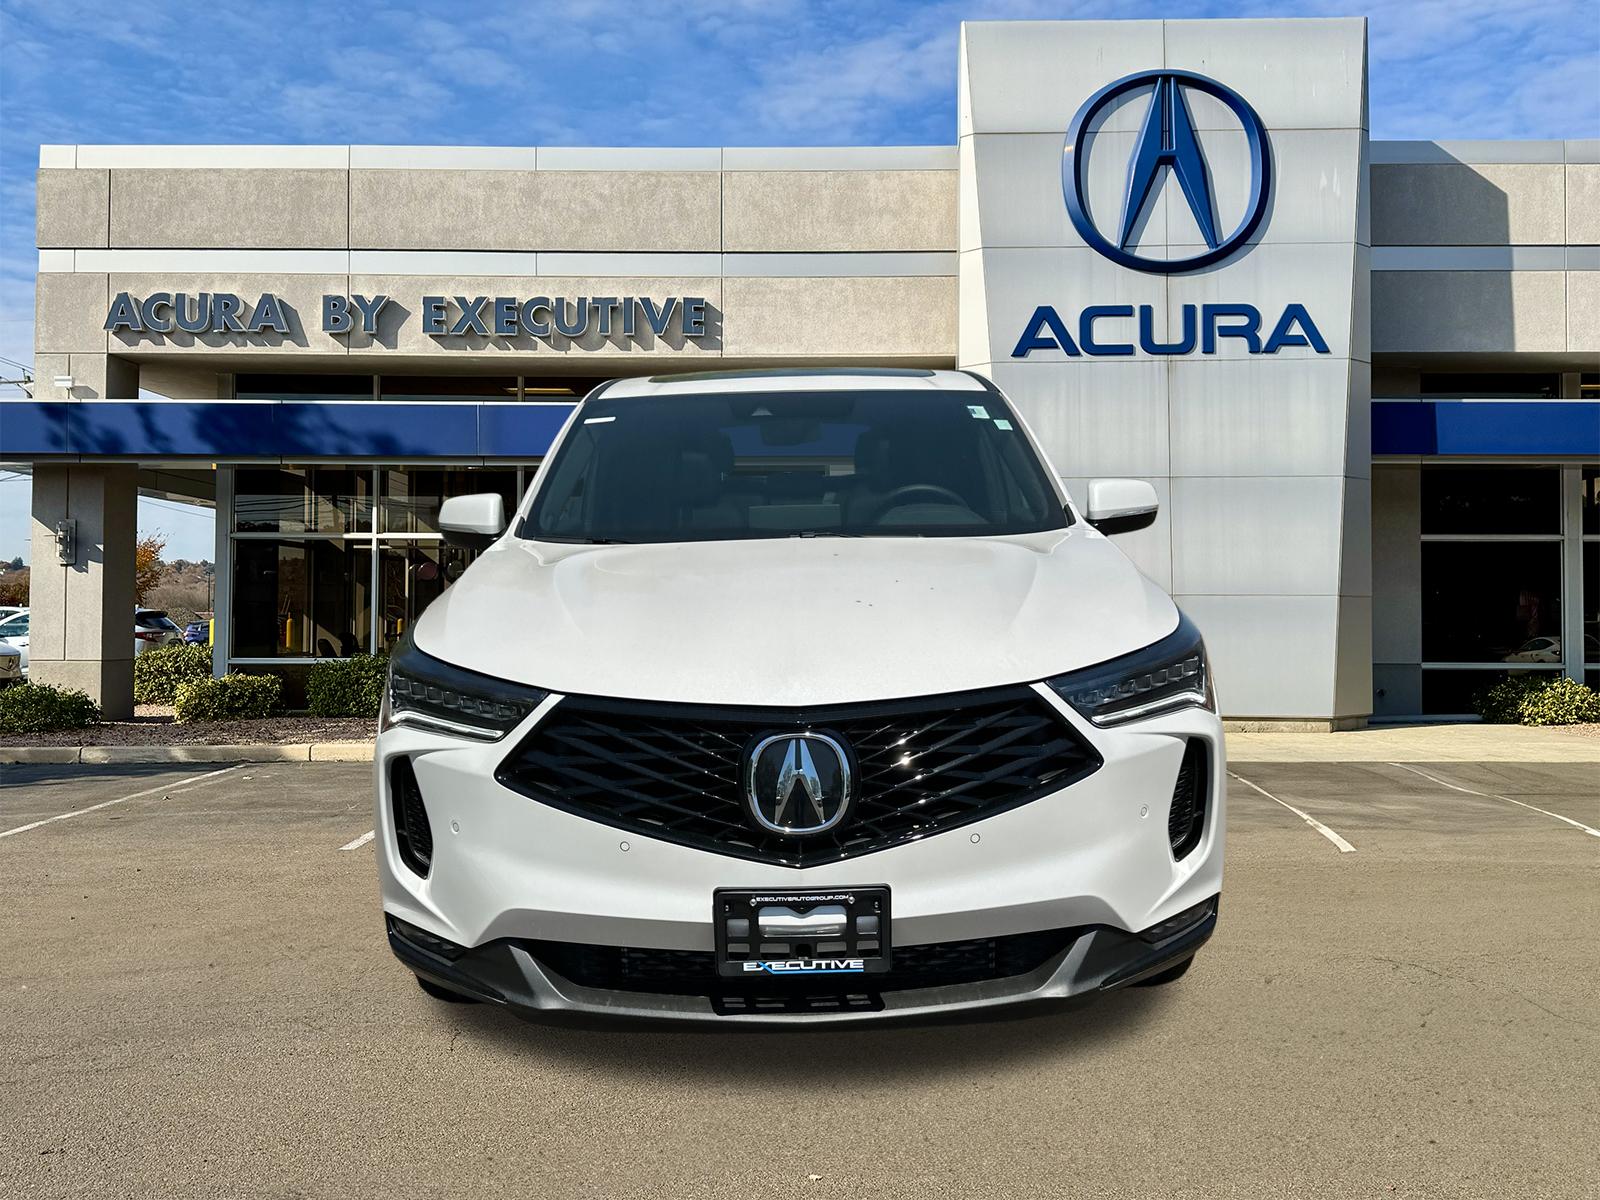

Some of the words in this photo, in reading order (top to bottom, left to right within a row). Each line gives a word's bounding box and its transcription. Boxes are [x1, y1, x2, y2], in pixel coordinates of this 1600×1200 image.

[104, 292, 289, 334] ACURA
[322, 294, 390, 335] BY
[422, 296, 707, 338] EXECUTIVE
[1011, 303, 1331, 357] ACURA
[755, 894, 849, 902] EXECUTIVEAUTOGROUP.COM
[743, 959, 864, 974] EXECUTIVE
